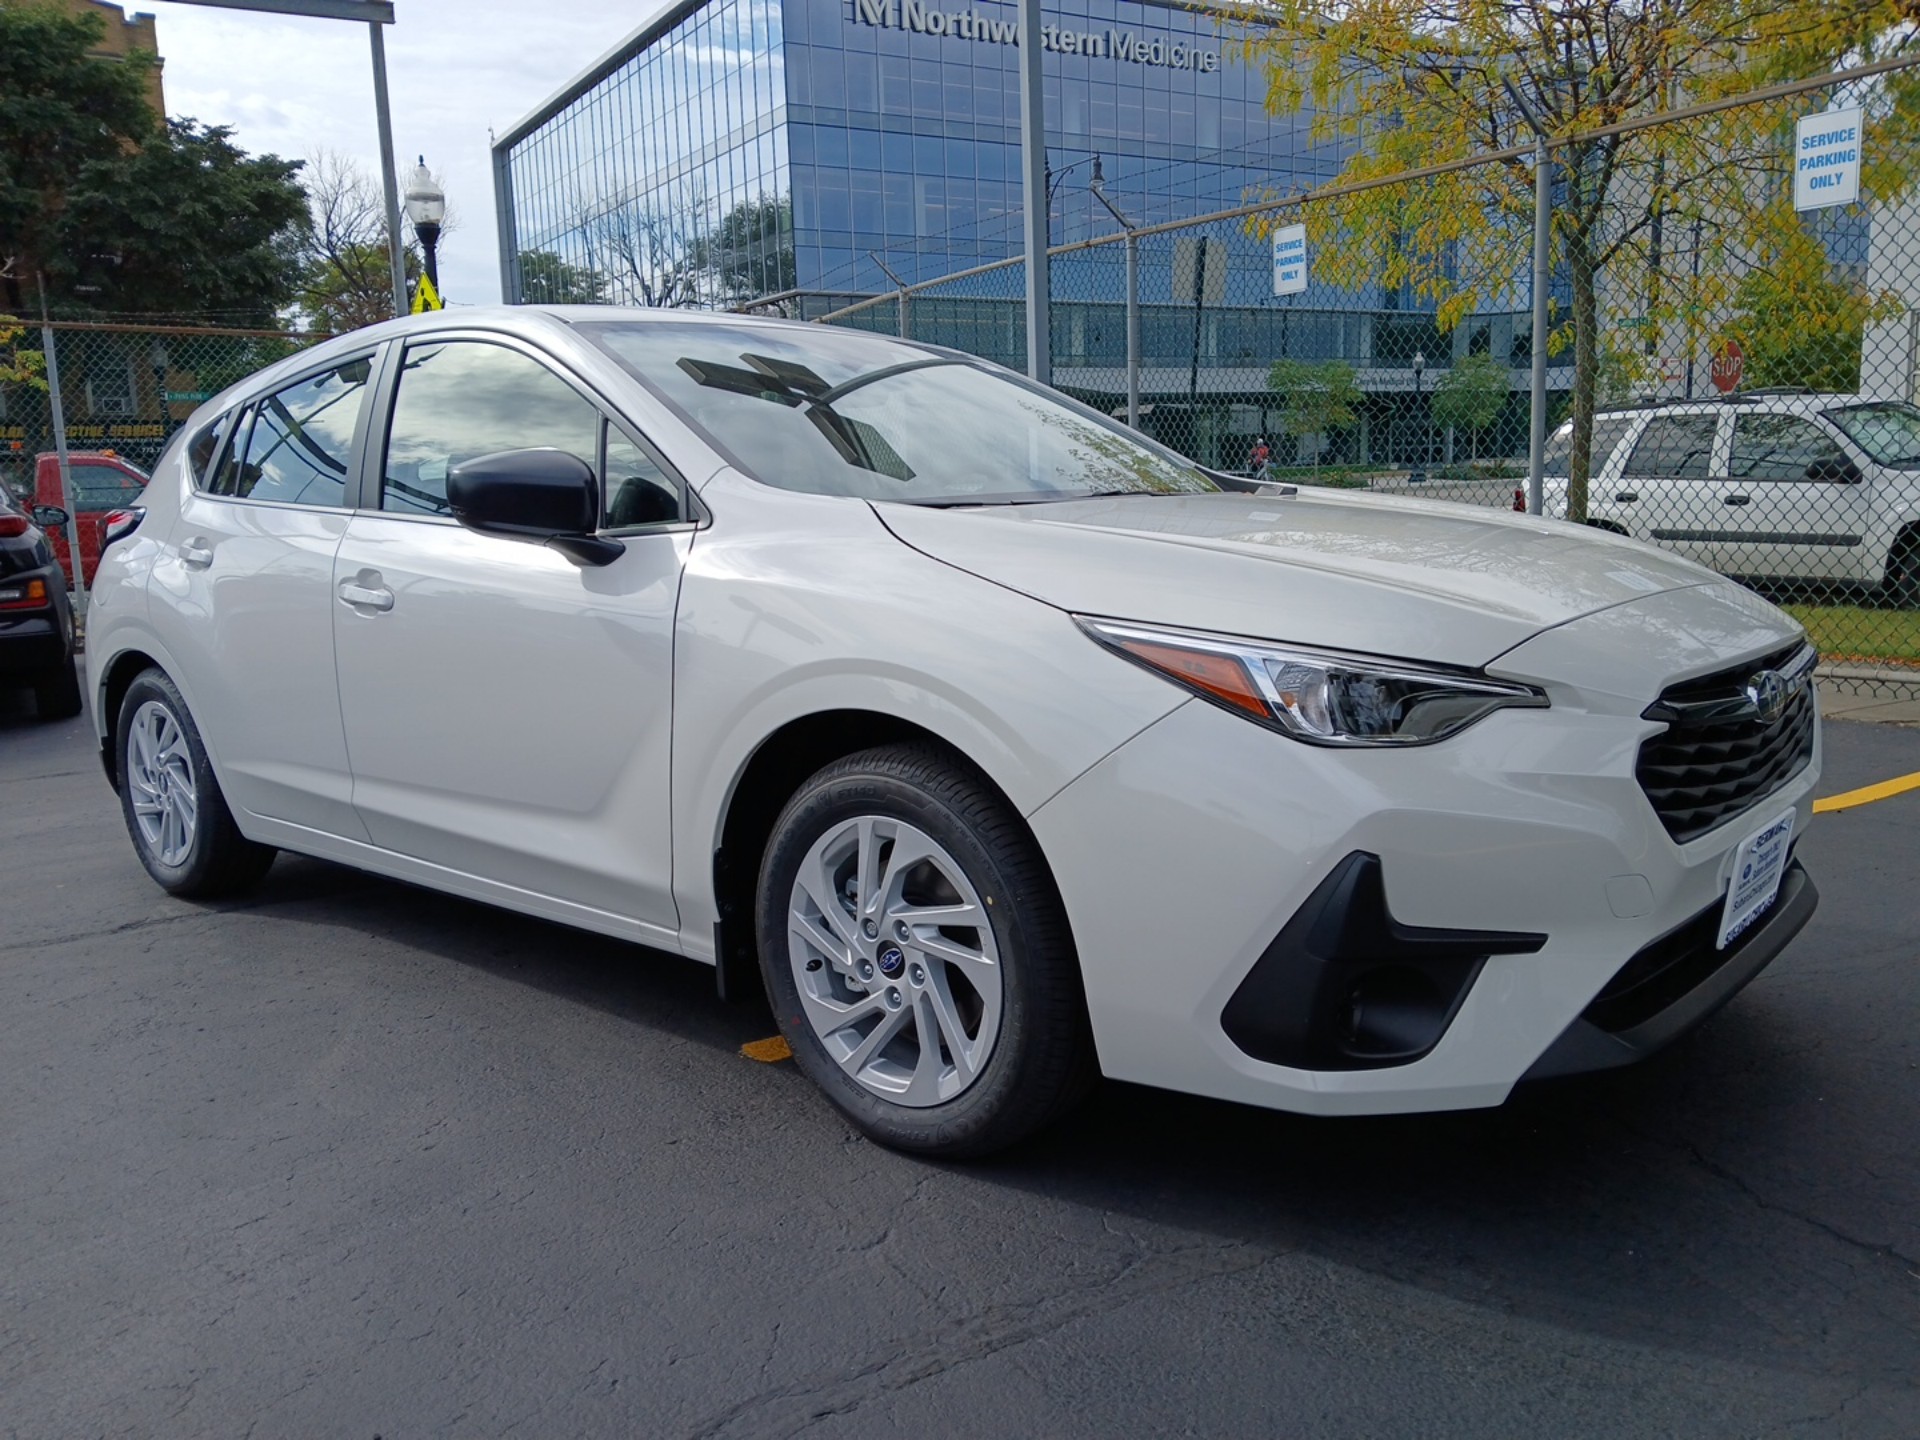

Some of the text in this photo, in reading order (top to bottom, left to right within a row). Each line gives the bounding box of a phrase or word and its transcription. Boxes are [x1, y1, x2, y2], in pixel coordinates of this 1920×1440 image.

[902, 0, 1218, 72] Northwstern Medicine
[1802, 127, 1856, 150] SERVICE
[1800, 149, 1856, 171] PARKING
[1810, 172, 1843, 190] ONLY
[1275, 239, 1303, 253] SERVICE
[1276, 253, 1304, 267] PARKING
[1281, 269, 1299, 281] ONLY
